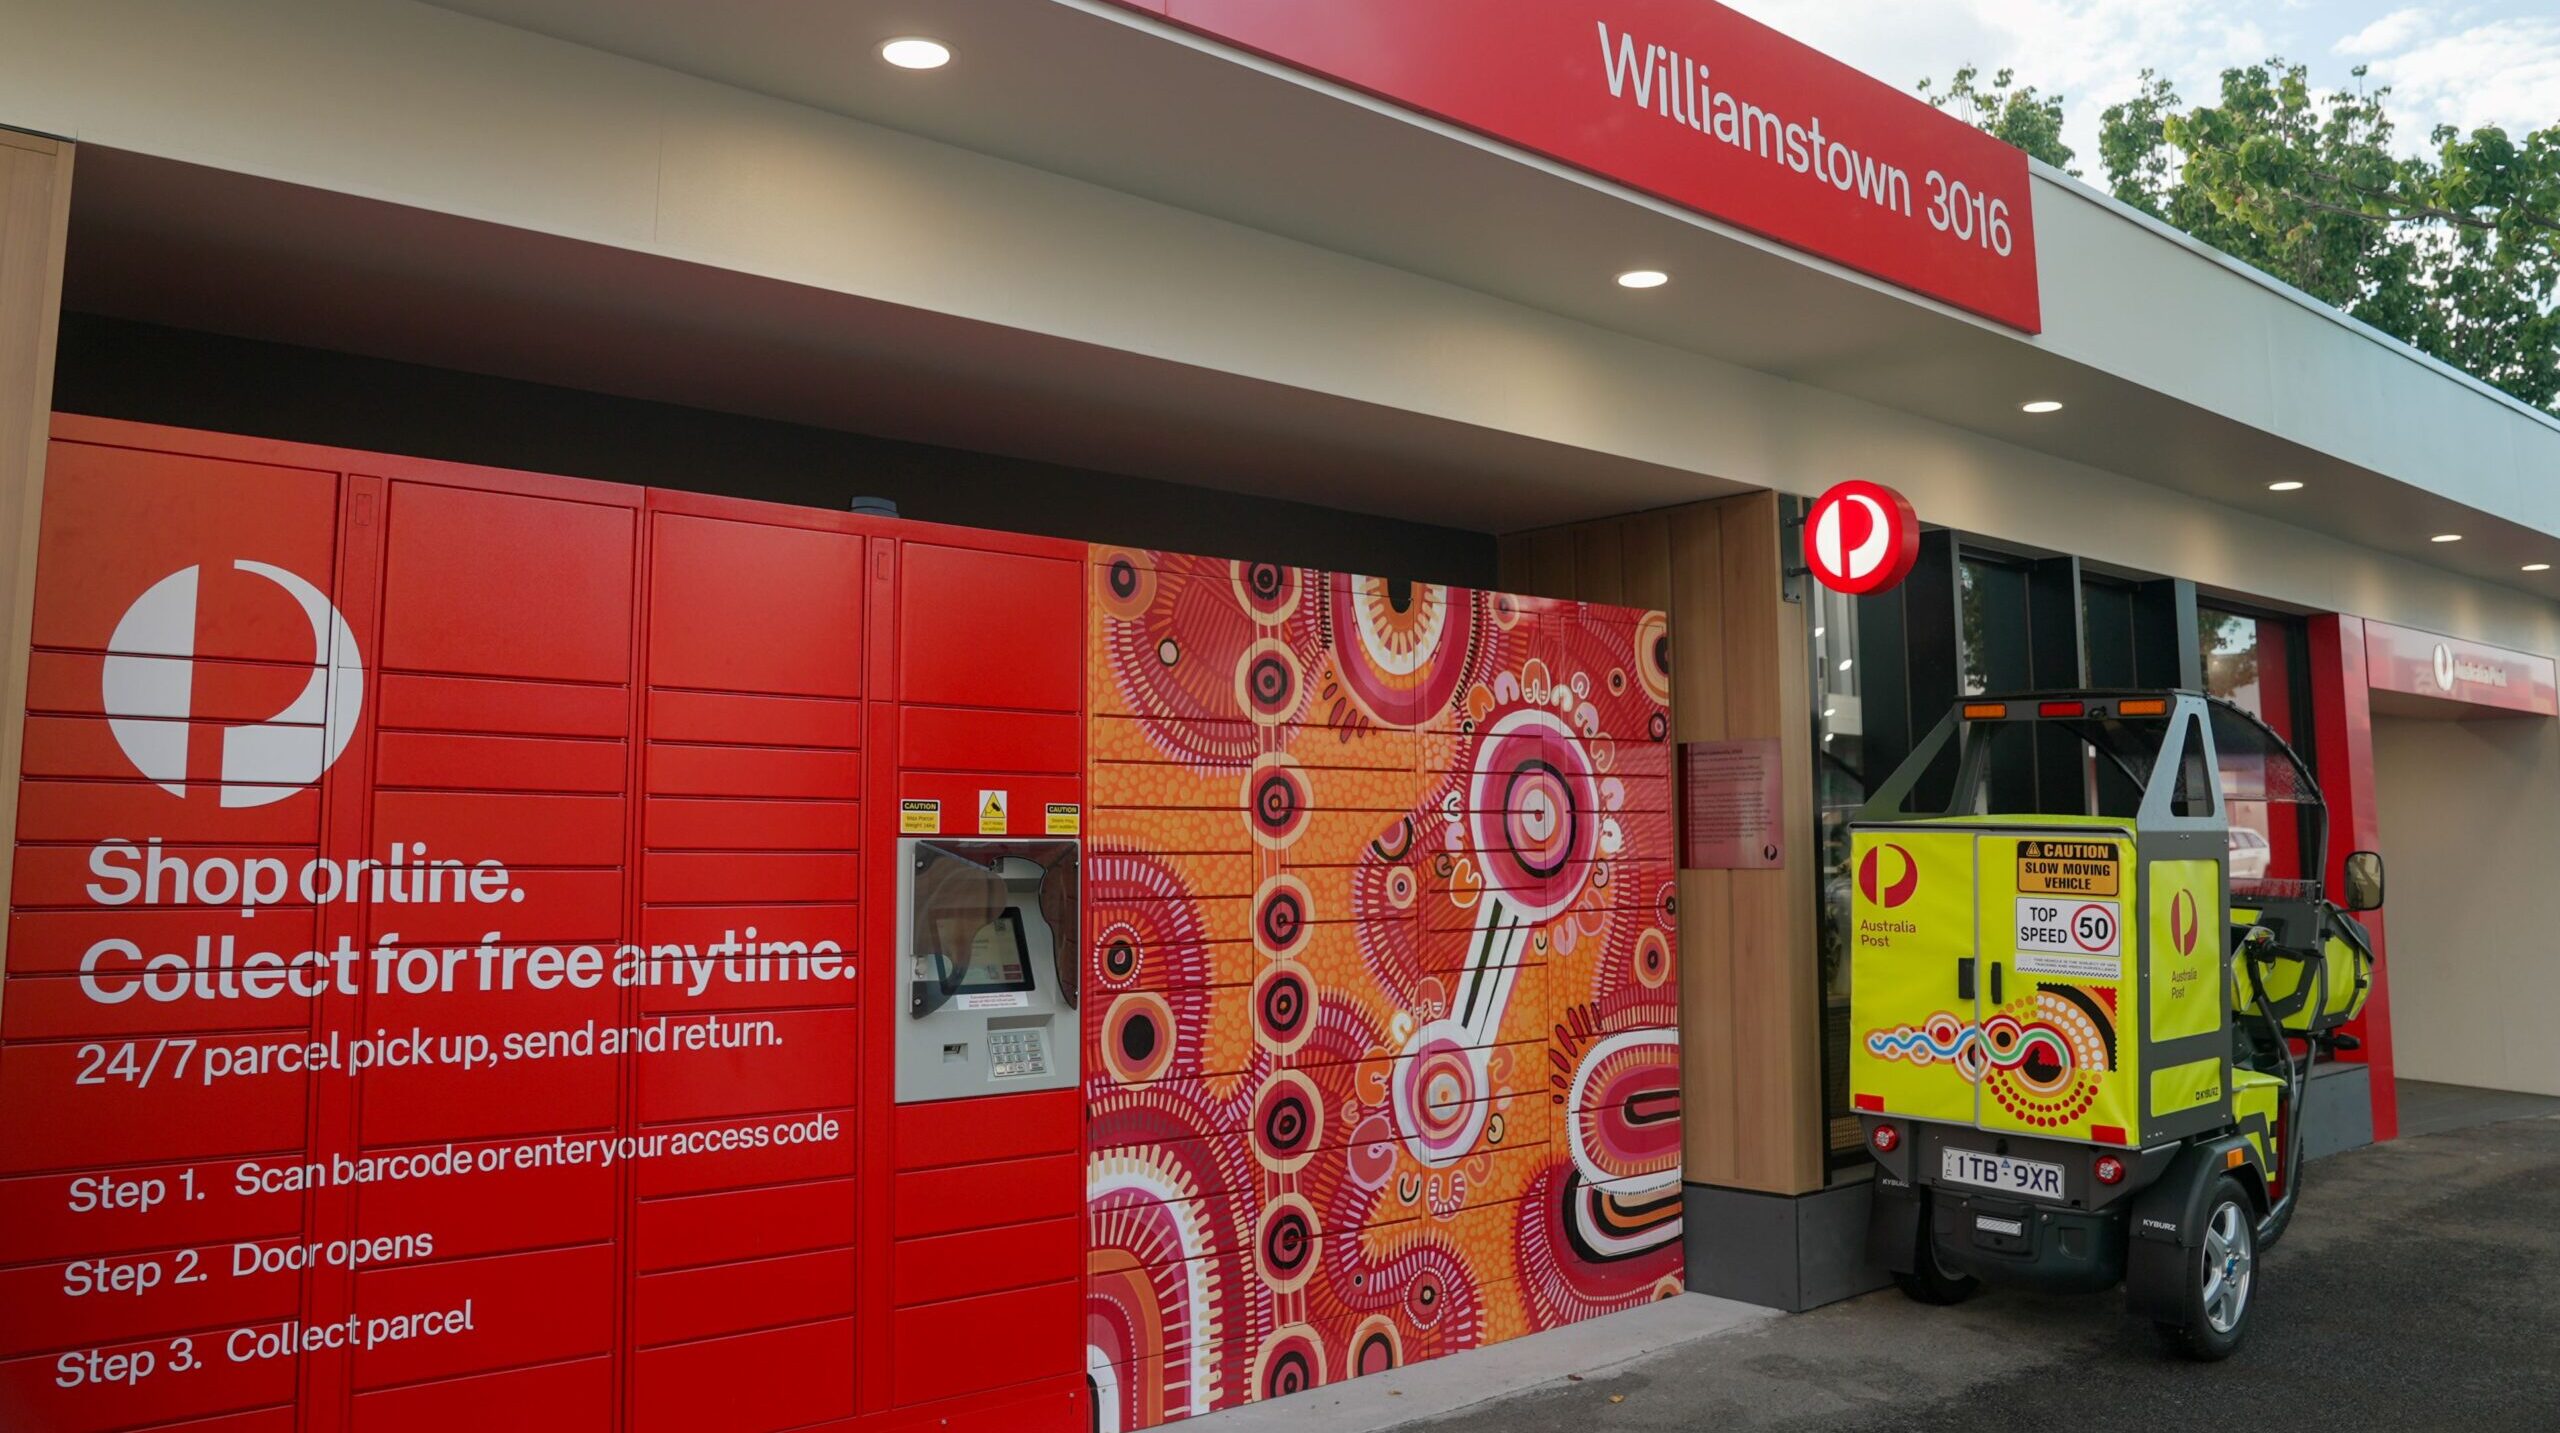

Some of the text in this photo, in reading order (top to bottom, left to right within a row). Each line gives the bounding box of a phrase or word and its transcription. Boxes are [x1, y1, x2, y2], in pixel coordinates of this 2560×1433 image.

[1597, 20, 2012, 257] Williamstown 3016
[904, 802, 937, 810] CAUTION
[1048, 806, 1078, 814] CAUTION
[2043, 844, 2109, 859] CAUTION
[2025, 861, 2111, 876] SLOW MOVING
[84, 838, 526, 917] Shop online.
[2044, 876, 2092, 890] VEHICLE
[2029, 906, 2058, 922] TOP
[1860, 919, 1917, 934] Australia
[2078, 917, 2109, 940] 50
[1861, 934, 1890, 948] Post
[2020, 926, 2068, 944] SPEED
[79, 926, 856, 1004] Collect for free anytime.
[2171, 968, 2198, 983] Australia
[2171, 985, 2185, 1000] Post
[75, 1015, 783, 1089] 24/7 parcel pick up, send and return.
[68, 1114, 840, 1213] Step 1. Scan barcode or enter your access code
[2143, 1219, 2176, 1232] KYBURZ
[63, 1230, 434, 1297] Step 2. Door opens
[56, 1300, 475, 1388] Step 3. Collect parcel
